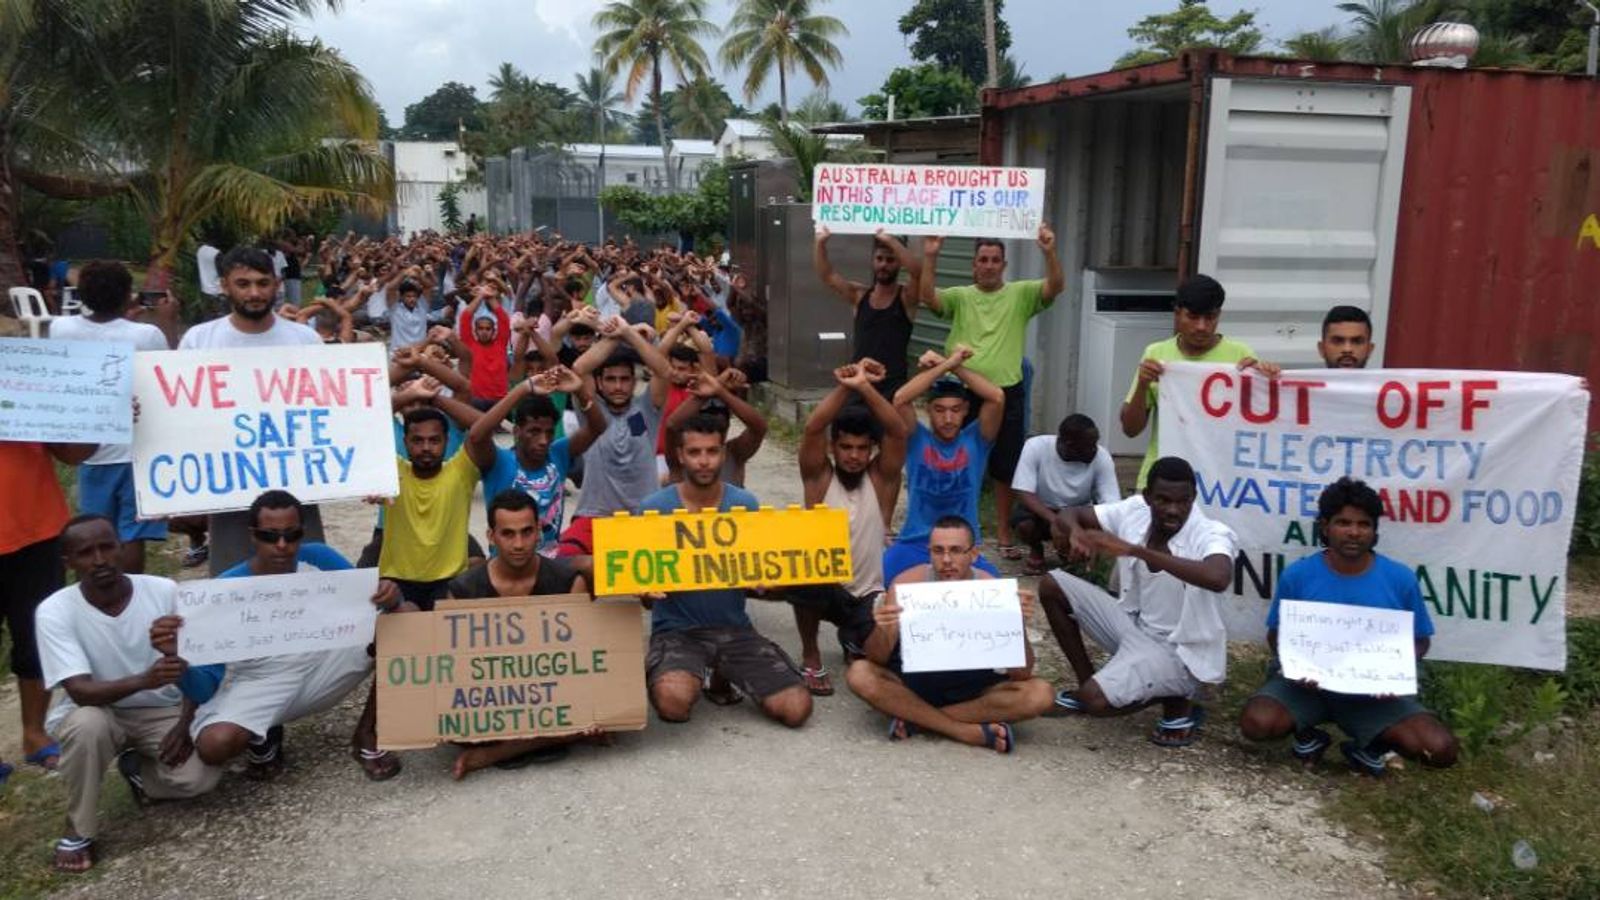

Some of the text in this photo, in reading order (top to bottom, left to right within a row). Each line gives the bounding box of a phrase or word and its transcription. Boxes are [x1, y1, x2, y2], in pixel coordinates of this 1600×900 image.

[924, 168, 1003, 188] BROUGHT
[1008, 170, 1028, 187] US
[949, 189, 967, 207] IT
[993, 189, 1029, 208] OUR
[154, 365, 382, 409] WE WANT
[1201, 372, 1498, 431] CUT OFF
[235, 408, 332, 449] SAFE
[149, 446, 356, 498] COUNTRY
[1233, 430, 1487, 480] ELECTRCTY
[1195, 470, 1563, 527] WATE AND FOOD
[674, 516, 737, 550] NO
[606, 549, 681, 588] FOR
[969, 587, 1004, 610] NZ
[387, 649, 609, 686] OUR STRUGGLE
[451, 681, 559, 710] AGAINST
